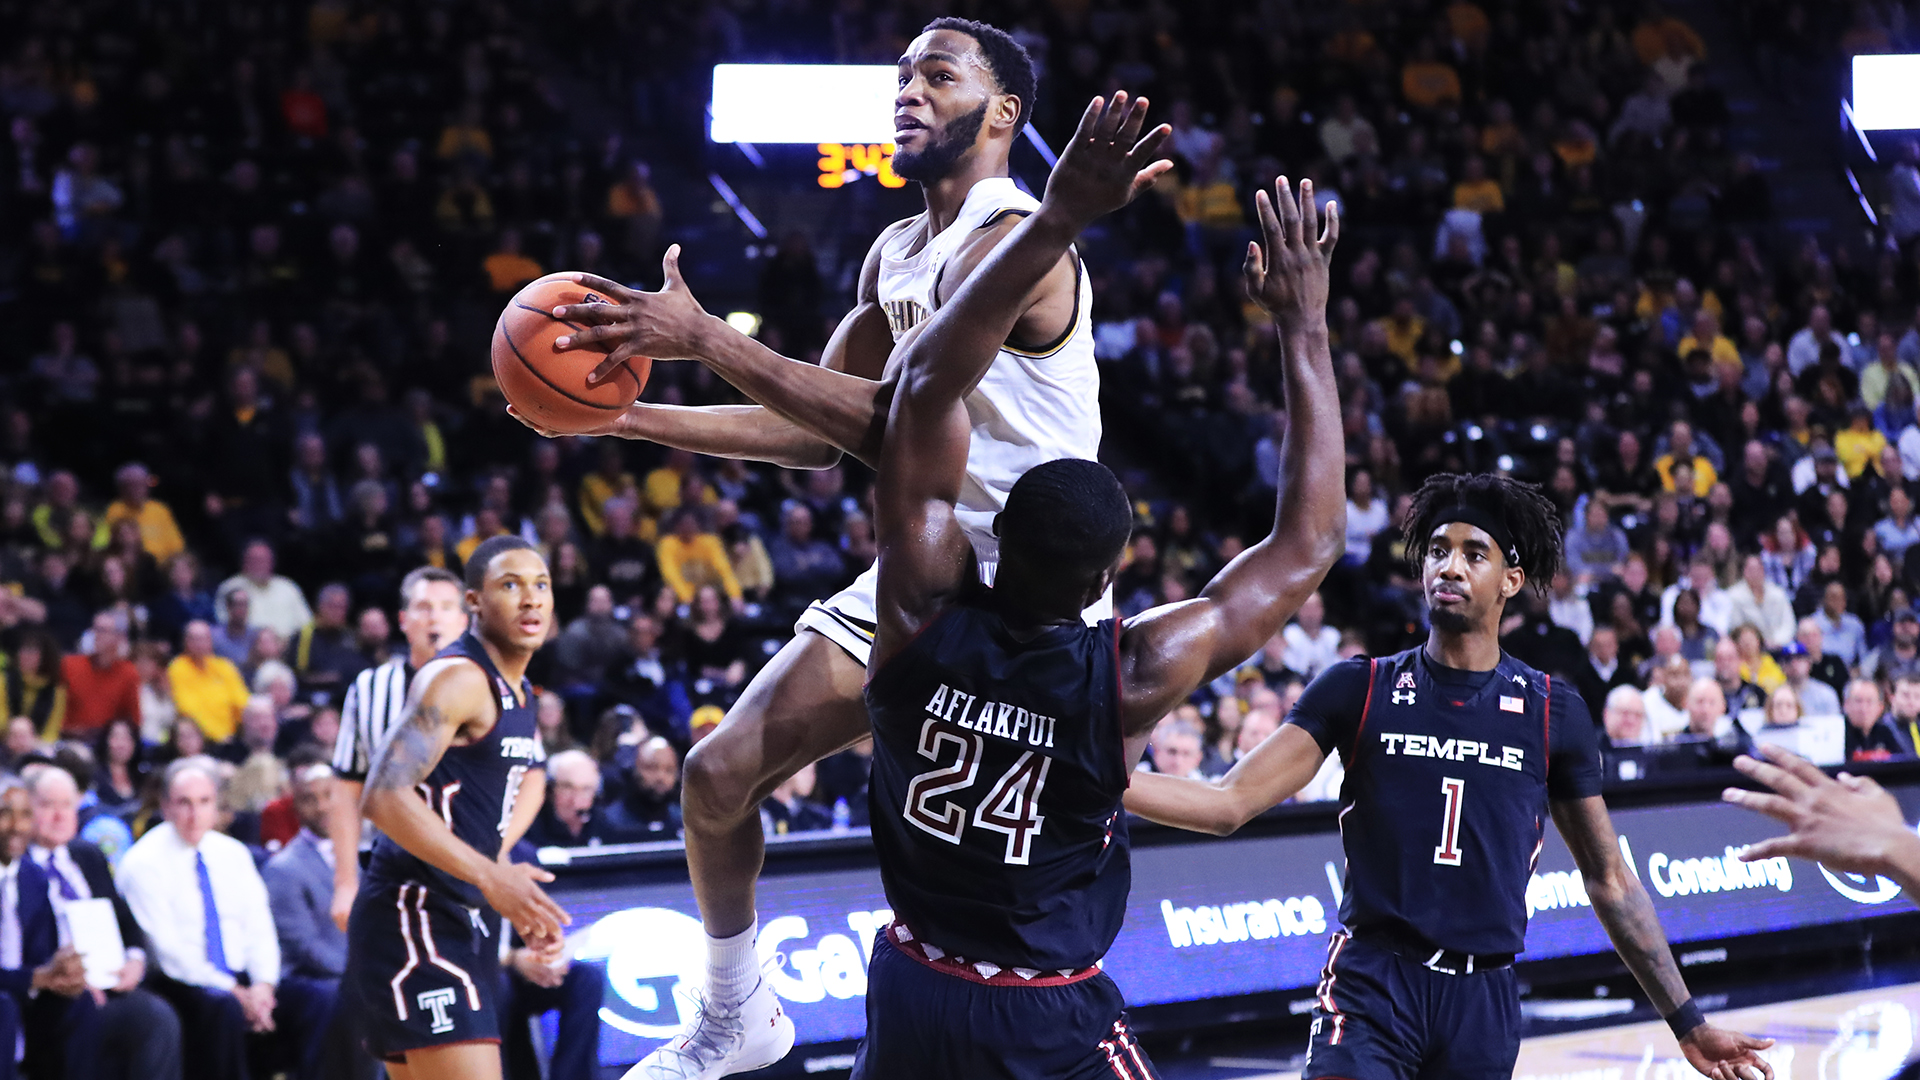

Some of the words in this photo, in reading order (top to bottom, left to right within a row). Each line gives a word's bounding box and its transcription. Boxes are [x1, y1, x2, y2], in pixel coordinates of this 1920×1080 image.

[925, 683, 1056, 748] AFLAKPUI
[1380, 733, 1524, 771] TEMPLE
[903, 717, 1052, 866] 24
[1433, 776, 1465, 867] 1
[1160, 895, 1327, 948] Insurance
[1648, 844, 1793, 897] Consulting
[417, 986, 456, 1034] T
